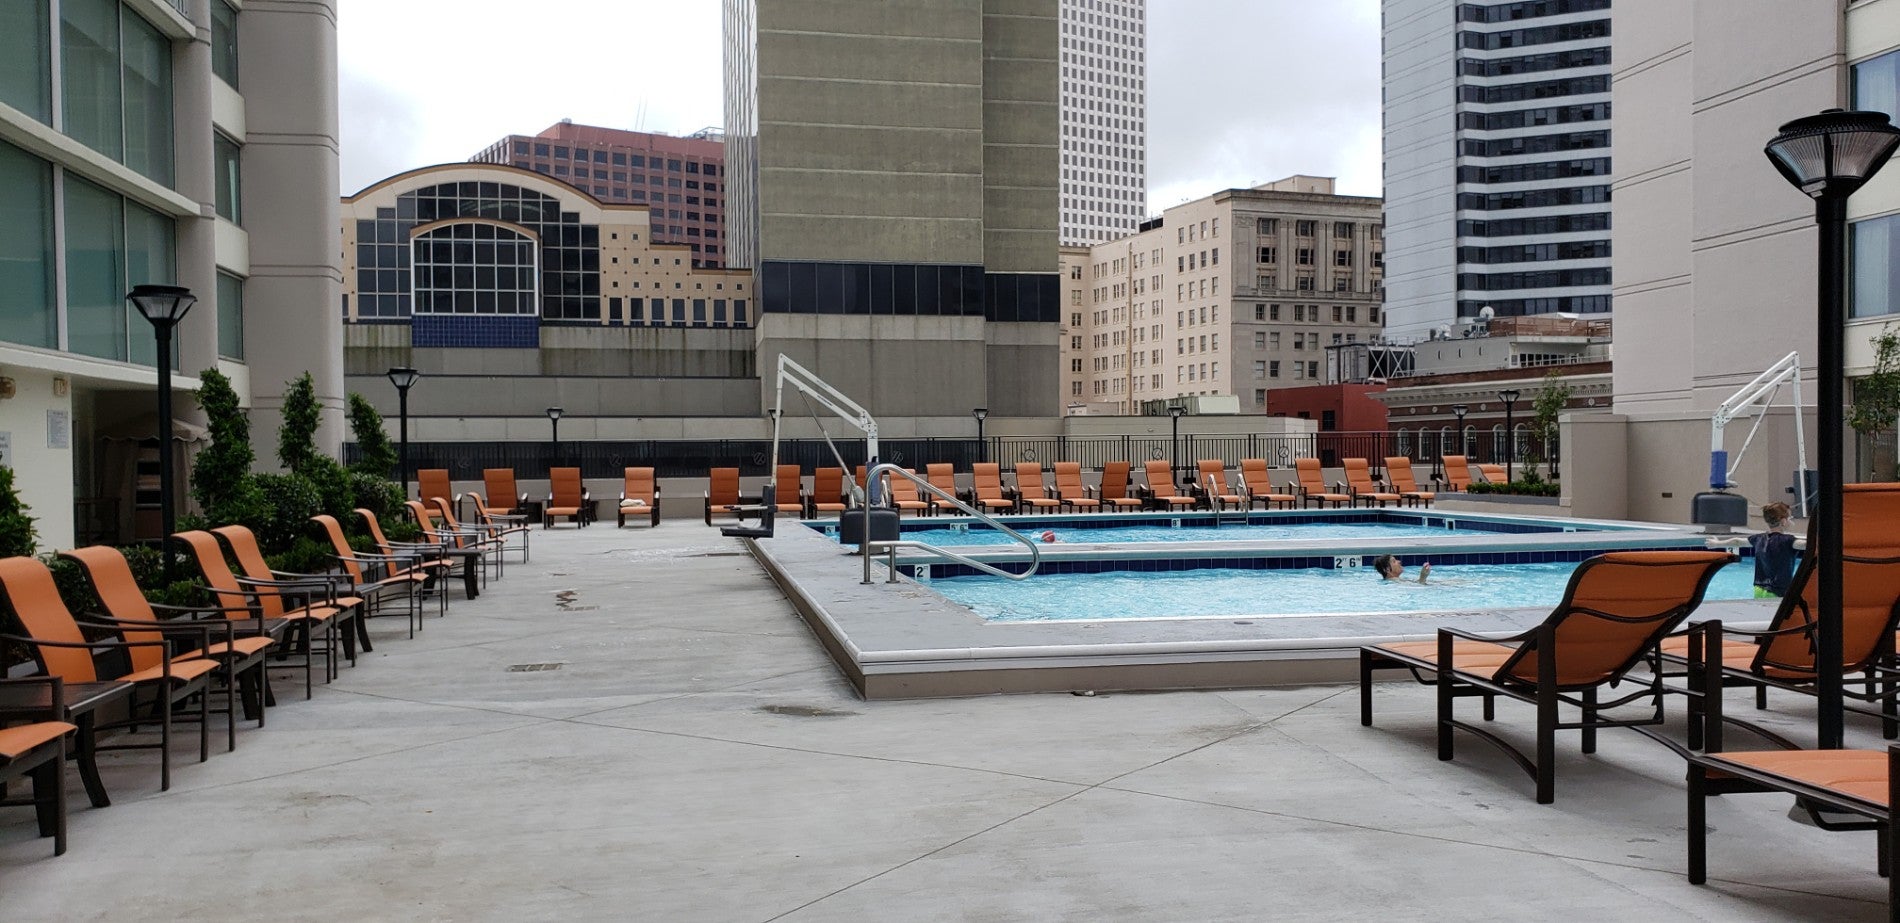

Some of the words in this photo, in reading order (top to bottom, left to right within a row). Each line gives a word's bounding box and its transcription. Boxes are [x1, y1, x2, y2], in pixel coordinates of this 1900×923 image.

[1336, 558, 1342, 569] 2
[1349, 557, 1355, 568] 6
[916, 566, 923, 578] 2
